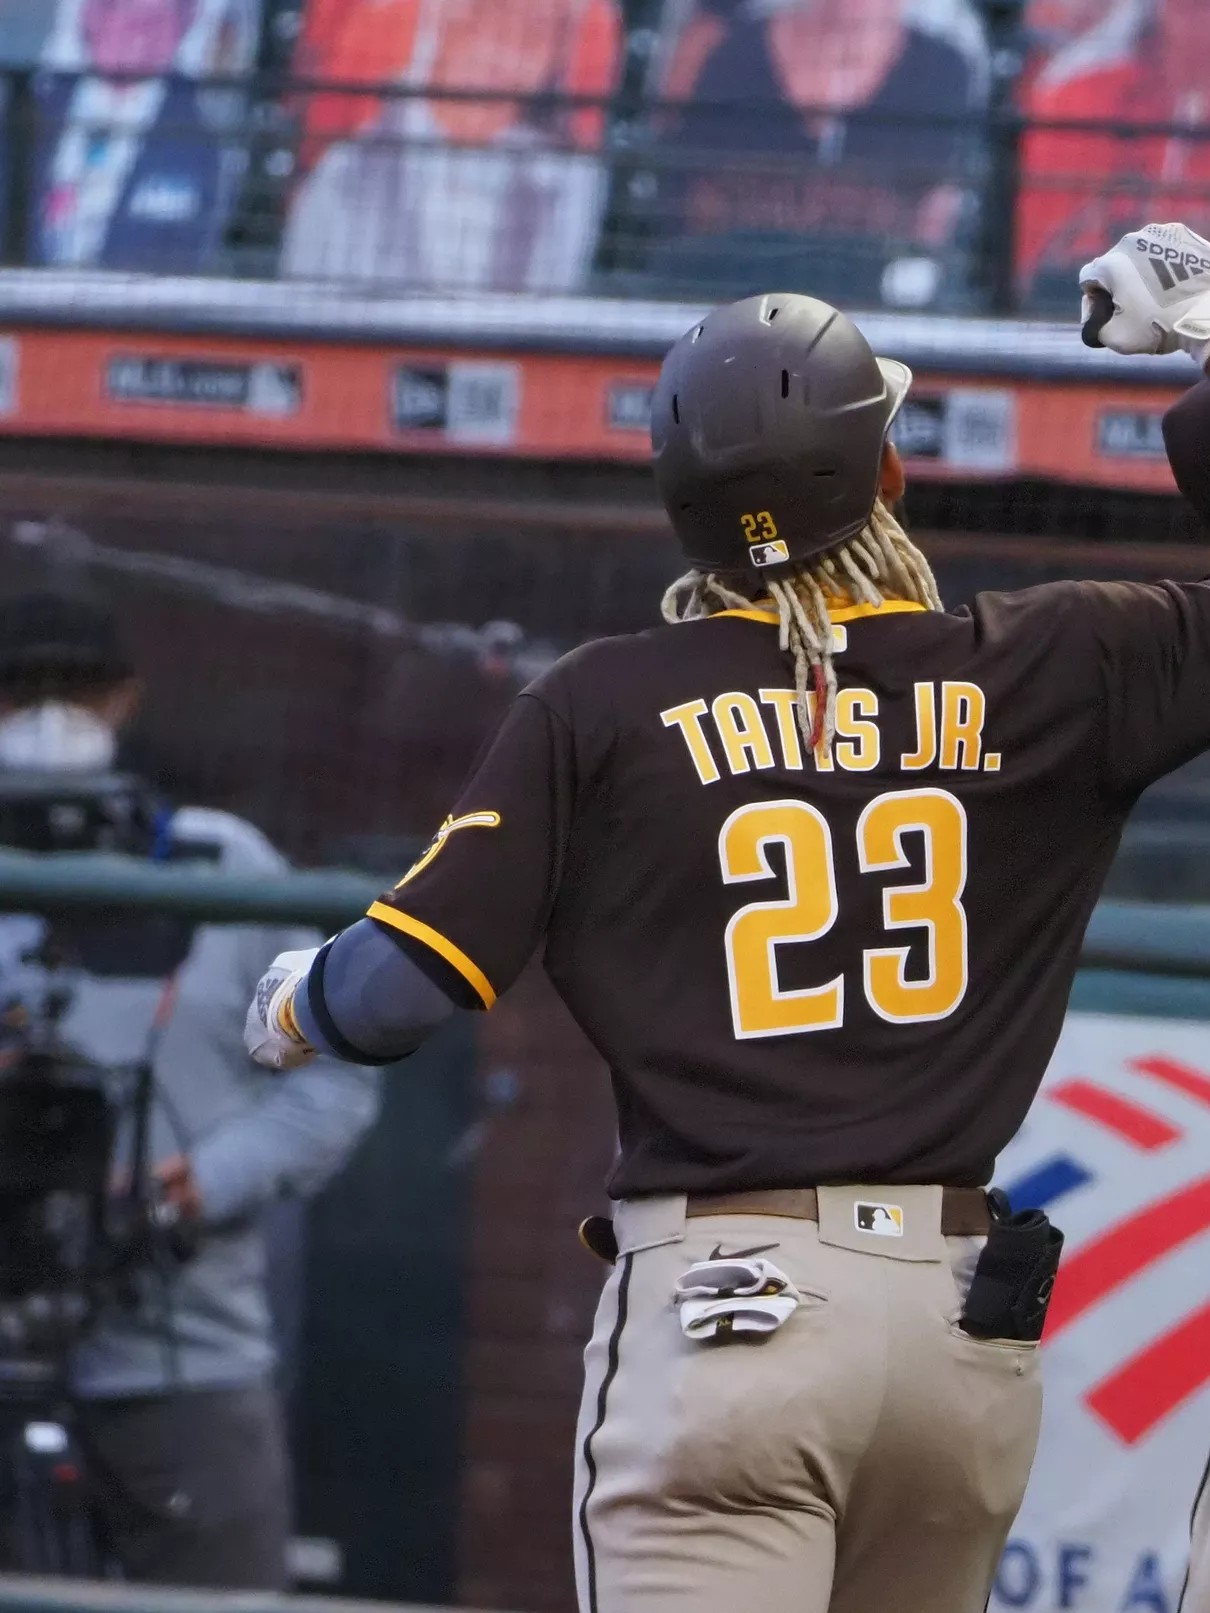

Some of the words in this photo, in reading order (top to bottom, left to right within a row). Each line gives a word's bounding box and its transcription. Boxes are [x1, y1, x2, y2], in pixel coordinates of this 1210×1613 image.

[740, 511, 777, 542] 23
[660, 688, 881, 785] TATIS
[901, 681, 1002, 772] JR.
[718, 787, 968, 1040] 23
[994, 1538, 1092, 1608] OF
